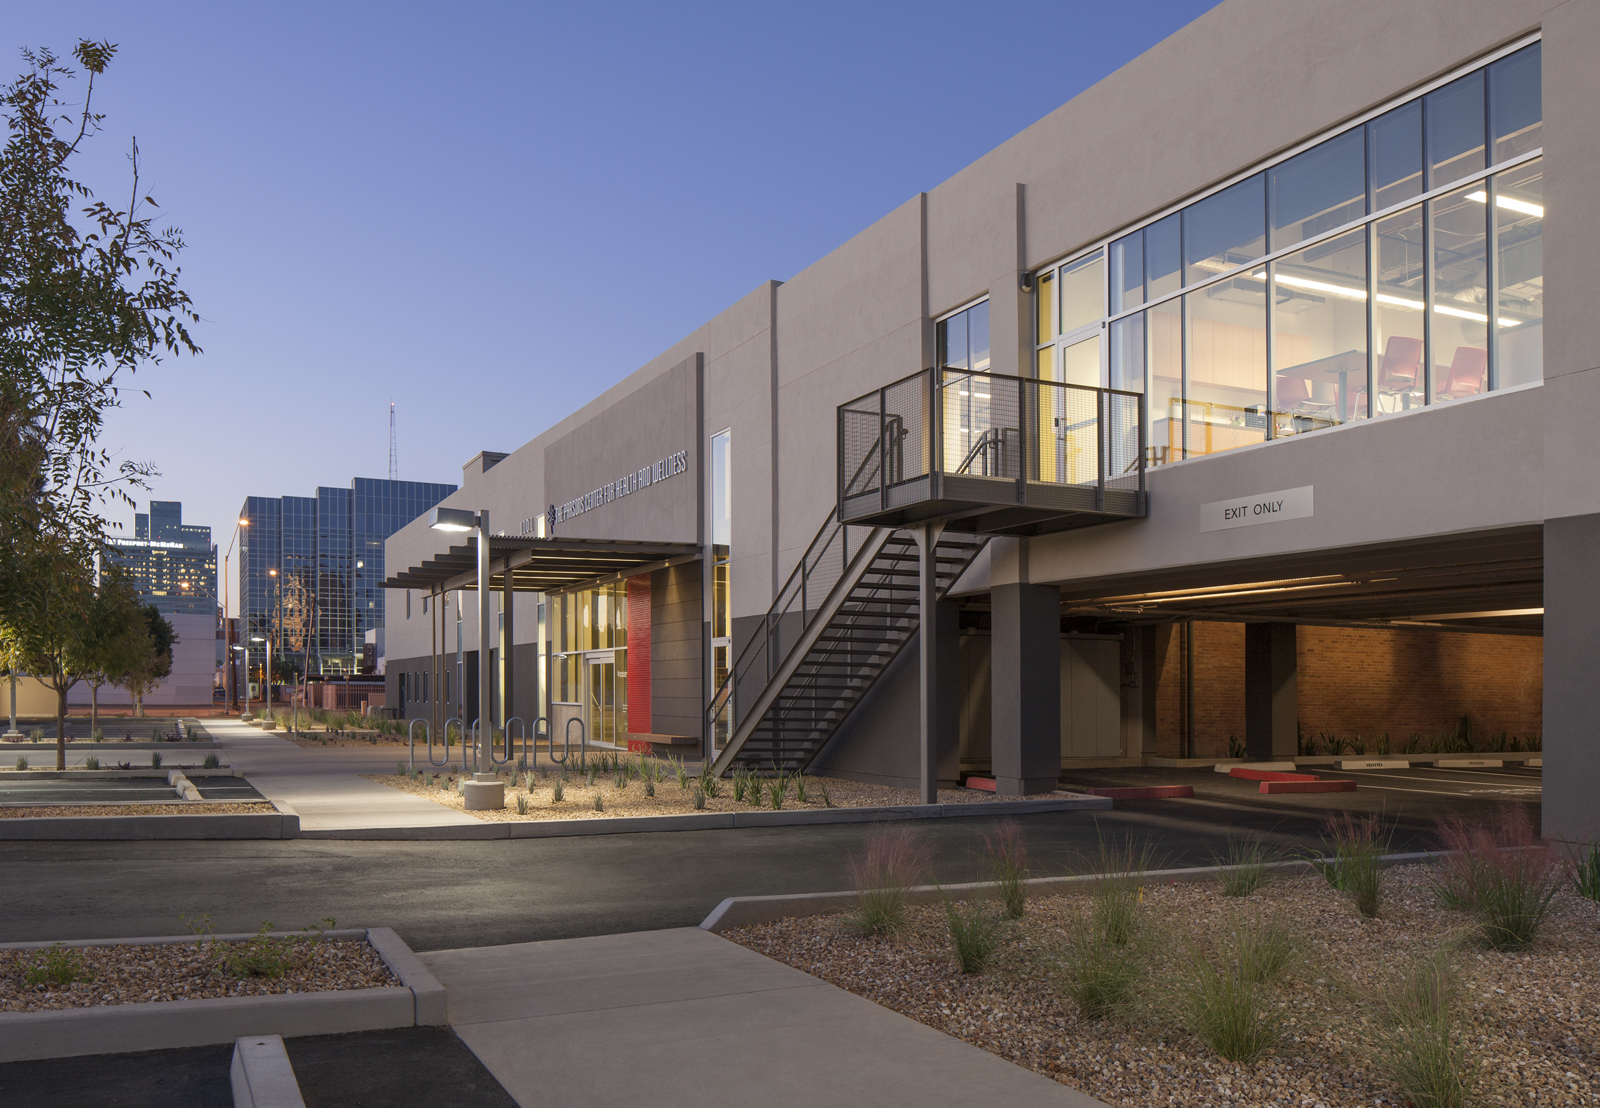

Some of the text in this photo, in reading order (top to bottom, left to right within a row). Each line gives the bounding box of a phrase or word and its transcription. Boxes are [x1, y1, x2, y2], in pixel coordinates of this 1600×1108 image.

[556, 505, 564, 523] THE
[585, 487, 603, 511] CENTER
[604, 482, 615, 503] FOR
[616, 472, 637, 499] HEALTH
[638, 466, 651, 489] AND
[652, 450, 687, 483] WELLNESS
[1224, 500, 1284, 520] EXIT ONLY
